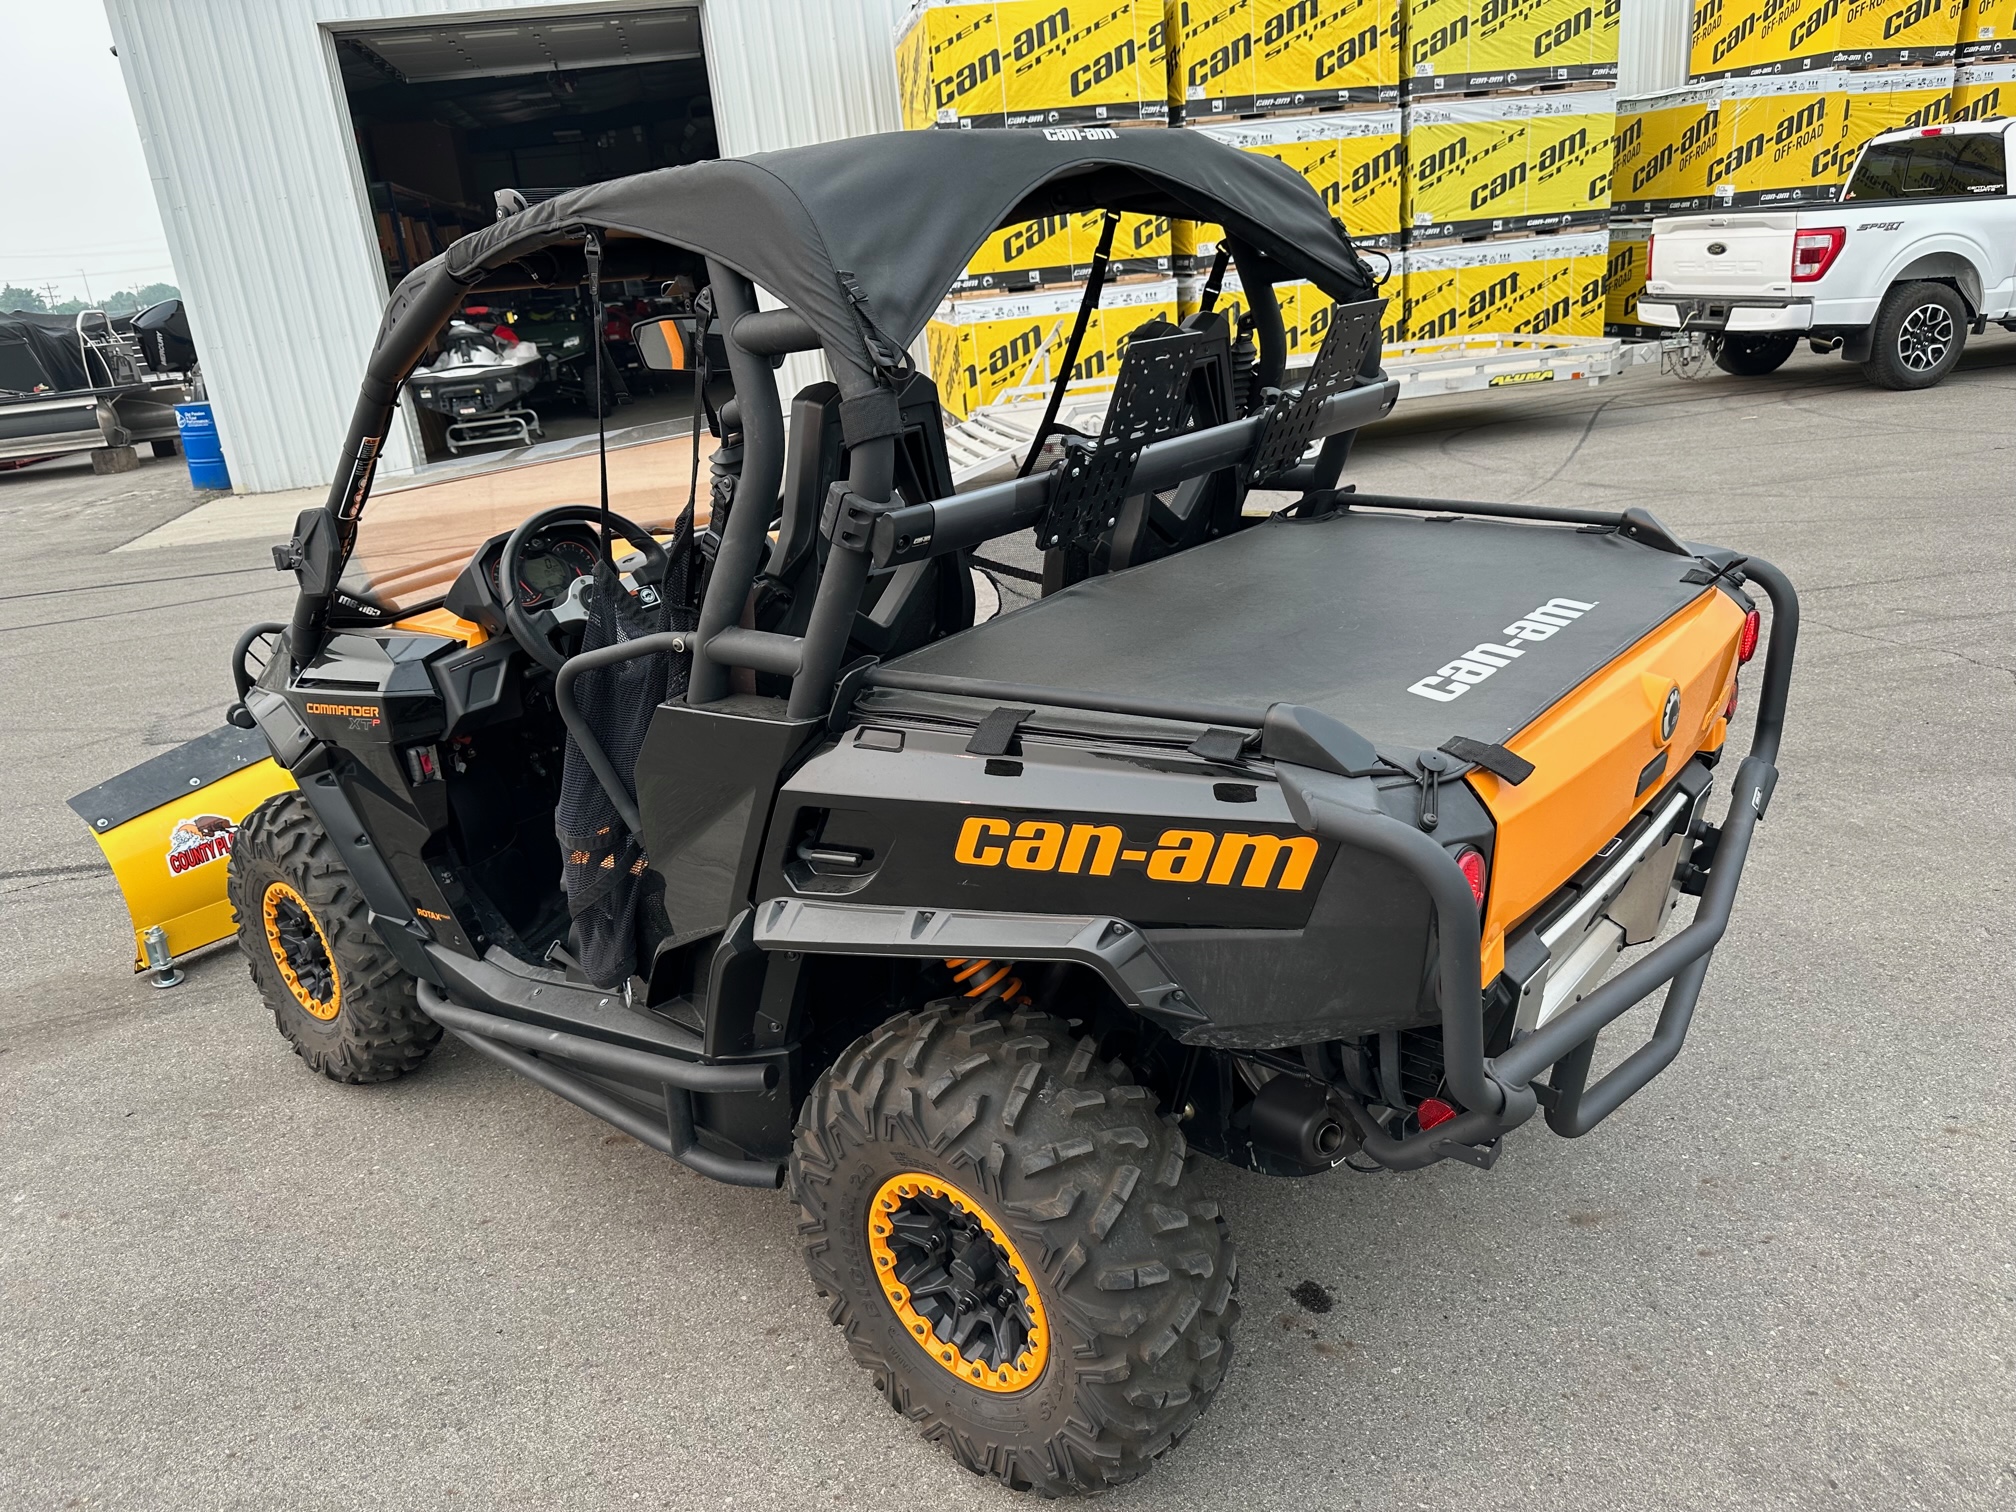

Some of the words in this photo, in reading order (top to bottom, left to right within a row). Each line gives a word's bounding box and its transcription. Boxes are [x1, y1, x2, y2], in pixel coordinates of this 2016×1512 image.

[935, 7, 1070, 110] can-am
[1188, 0, 1318, 87] can-am
[1470, 75, 1504, 86] can-am
[1008, 114, 1044, 125] can-am
[1256, 96, 1291, 107] can-am
[1418, 127, 1525, 195] SPYDER
[1632, 111, 1719, 194] can-am
[1679, 132, 1718, 173] OFF-ROAD
[1706, 97, 1826, 188] can-am
[1773, 123, 1824, 163] OFF-ROAD
[1470, 127, 1587, 211] can-am
[1761, 192, 1790, 201] can-am
[1468, 267, 1568, 332] SPYDER
[1490, 370, 1554, 387] ALUMA
[1406, 598, 1600, 702] can-am
[306, 702, 379, 718] COMMANDER
[170, 840, 217, 873] COUNTY
[954, 816, 1320, 891] can-am
[416, 907, 441, 921] ROTAX
